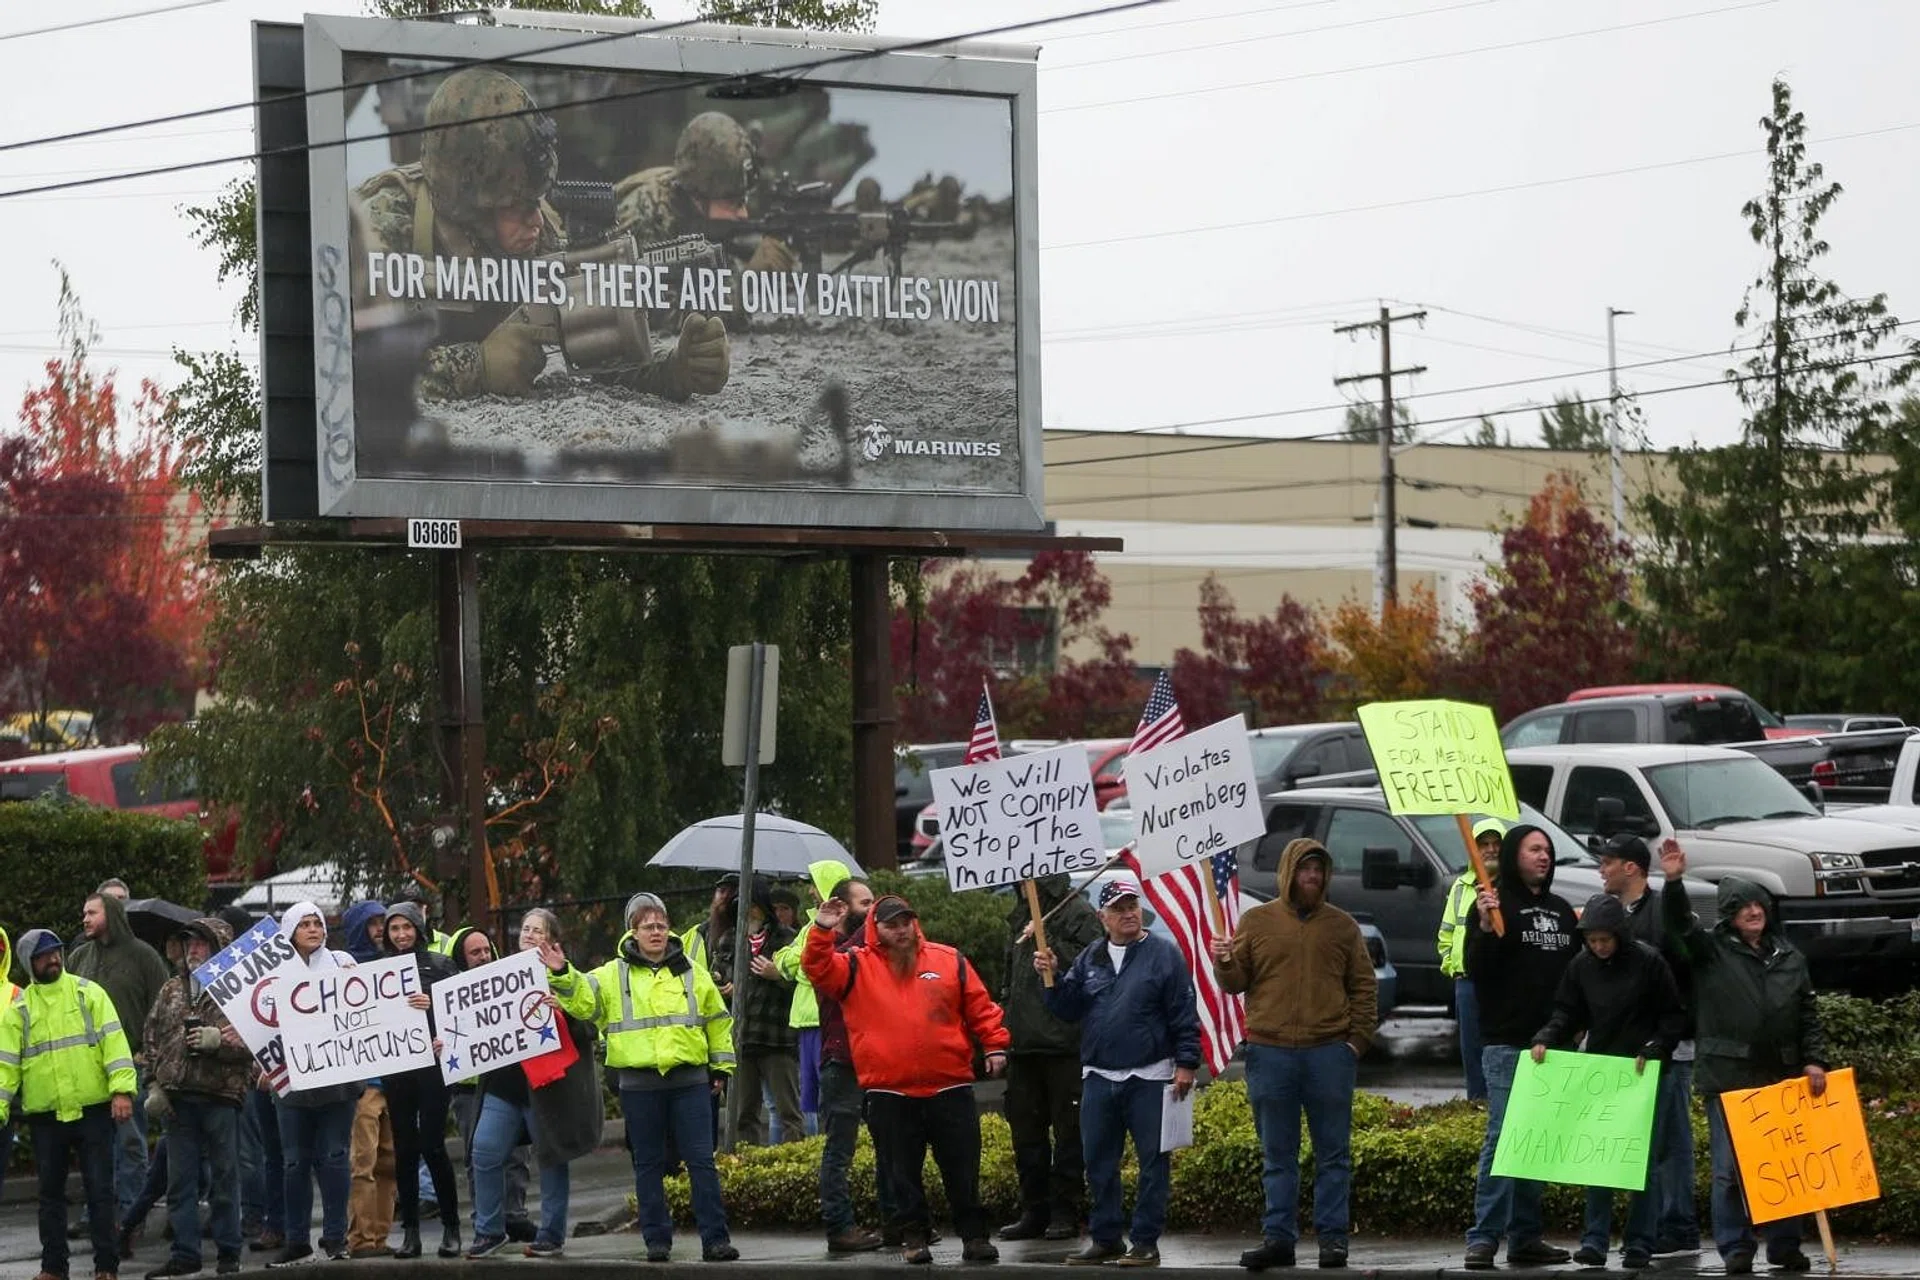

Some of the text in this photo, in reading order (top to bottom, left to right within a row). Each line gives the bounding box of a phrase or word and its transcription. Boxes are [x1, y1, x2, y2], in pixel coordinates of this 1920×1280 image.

[368, 252, 999, 322] FOR MARINES, THERE ARE ONLY BATTLES WON
[895, 440, 1001, 456] MARINES
[412, 521, 458, 545] 03686
[1394, 710, 1476, 740] STAND
[1145, 749, 1231, 790] Violates
[1387, 748, 1426, 766] FOR
[951, 759, 1061, 798] We Will
[1389, 767, 1509, 811] FREEDOM
[946, 801, 989, 830] NOT
[1141, 780, 1247, 836] Nuremberg
[950, 817, 1082, 861] Stop The
[1176, 825, 1226, 860] Code
[956, 846, 1097, 888] mandates
[208, 933, 295, 1007] NO JABS
[290, 967, 417, 1014] CHOICE
[445, 967, 535, 1015] FREEDOM
[333, 1007, 373, 1031] NOT
[476, 1001, 514, 1029] NOT
[290, 1028, 427, 1074] ULTIMATUMS
[470, 1028, 528, 1067] FORCE
[1531, 1062, 1634, 1098] STOP
[1552, 1101, 1615, 1122] THE
[1741, 1091, 1769, 1124] I
[1501, 1128, 1645, 1165] MANDATE
[1763, 1124, 1806, 1150] THE
[1758, 1143, 1841, 1206] SHOT
